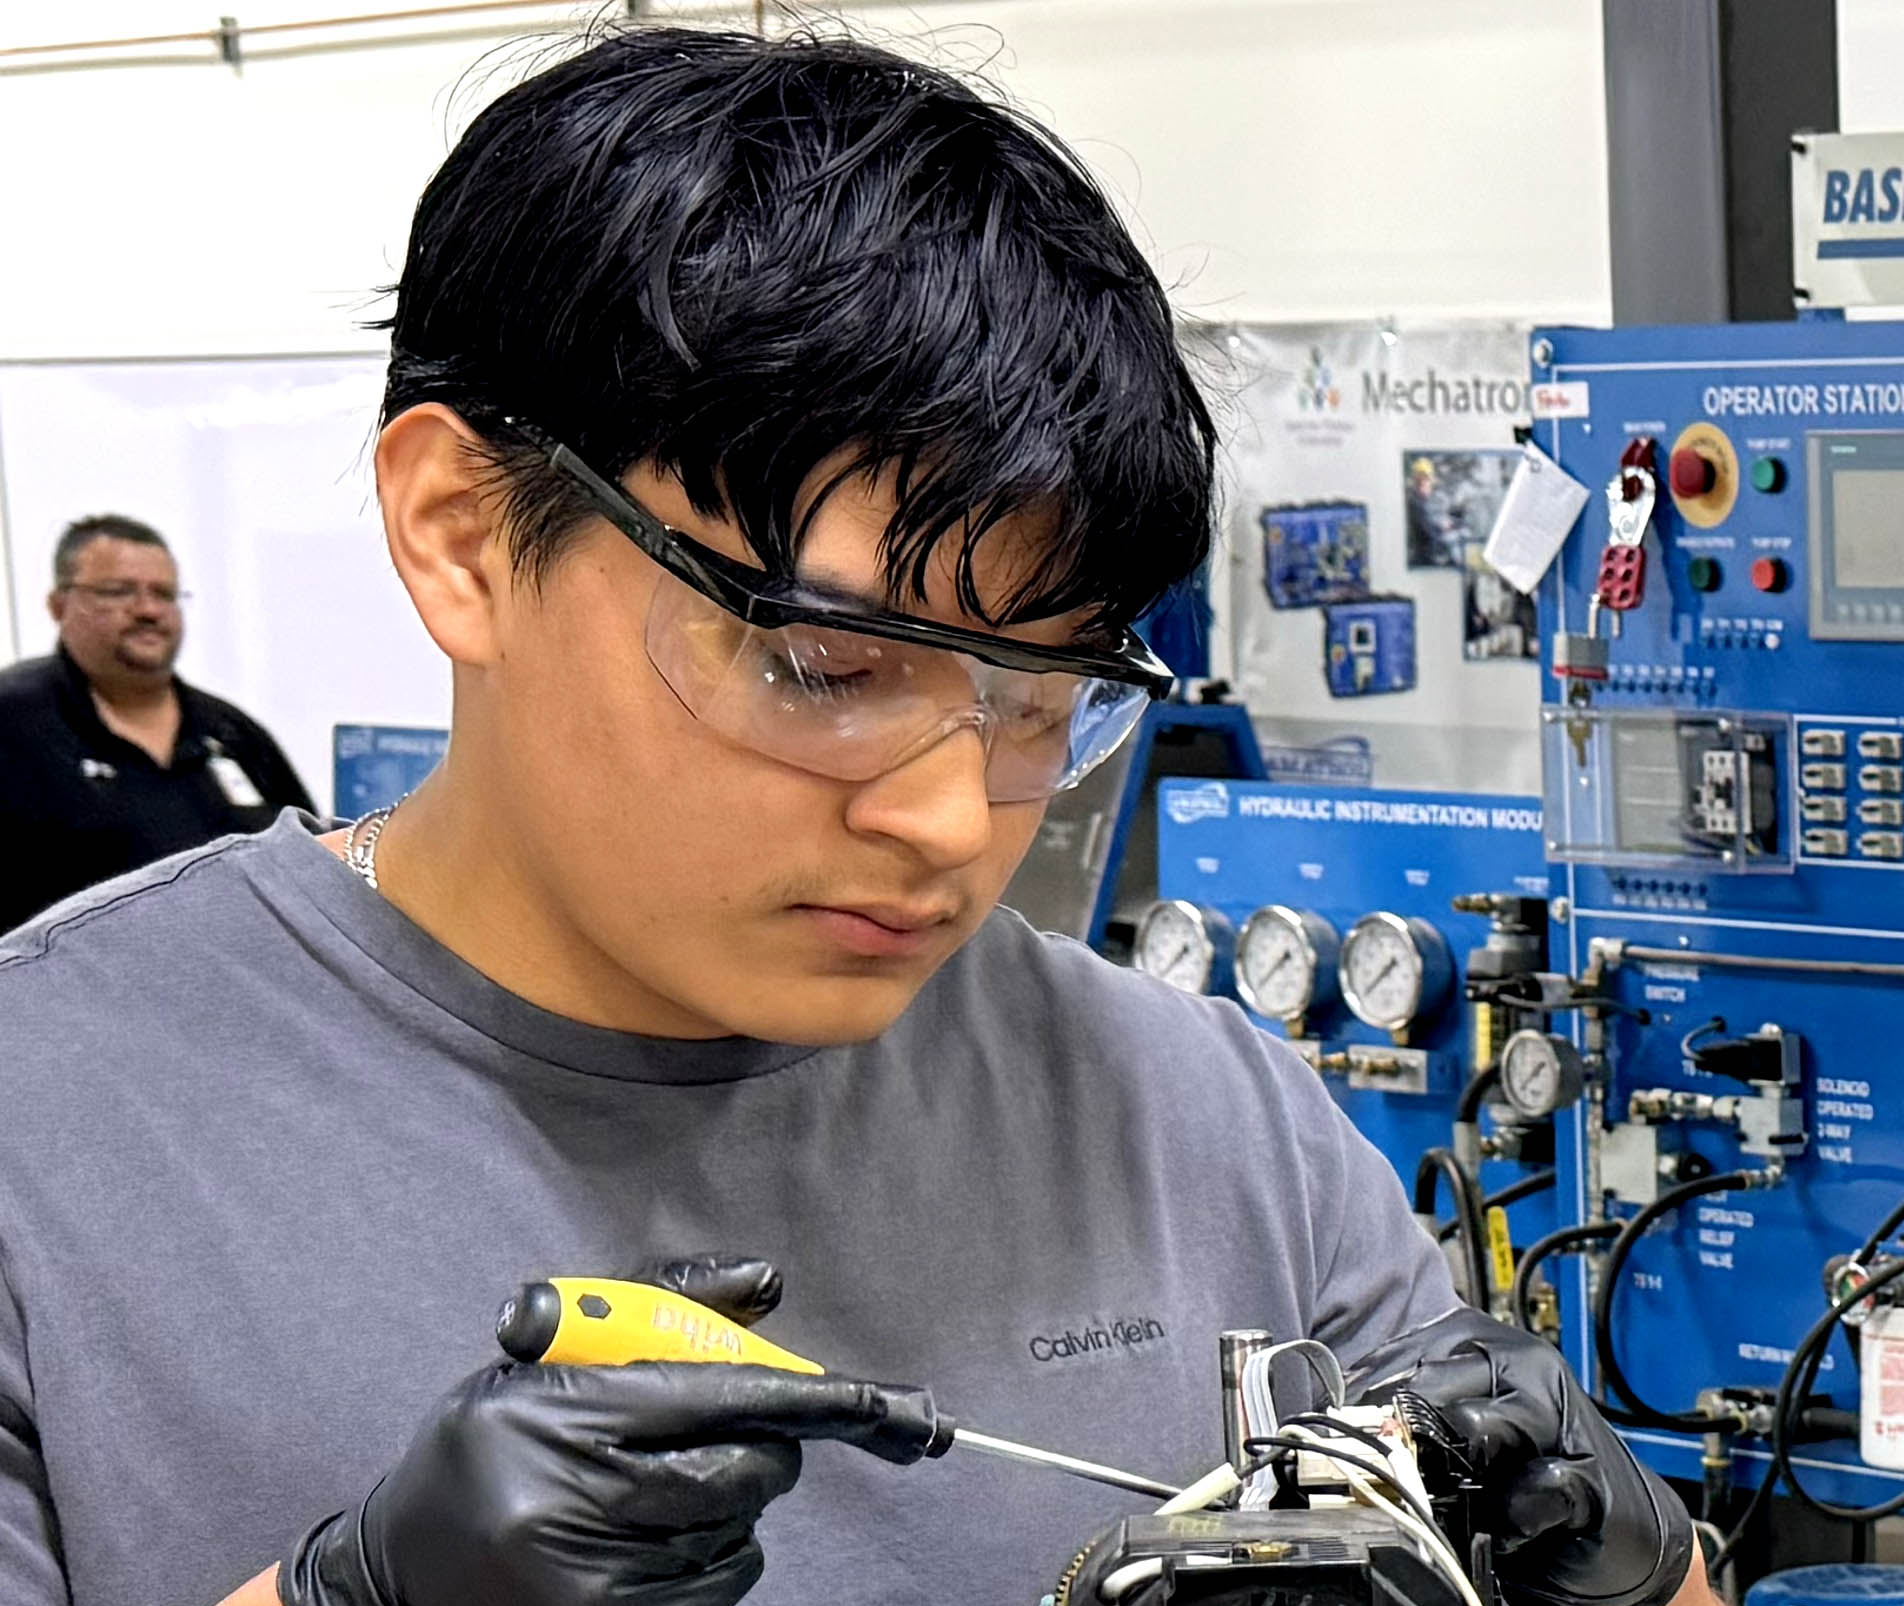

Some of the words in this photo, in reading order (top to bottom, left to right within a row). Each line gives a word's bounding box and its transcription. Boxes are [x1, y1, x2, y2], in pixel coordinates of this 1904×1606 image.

[1703, 384, 1820, 417] OPERATOR
[1238, 795, 1332, 821] HYDRAULIC
[1334, 799, 1488, 828] INSTRUMENTATION
[1491, 806, 1542, 832] MODU
[1816, 1100, 1874, 1120] OPERATED
[1029, 1327, 1111, 1362] Calvin
[1111, 1317, 1165, 1346] Klein
